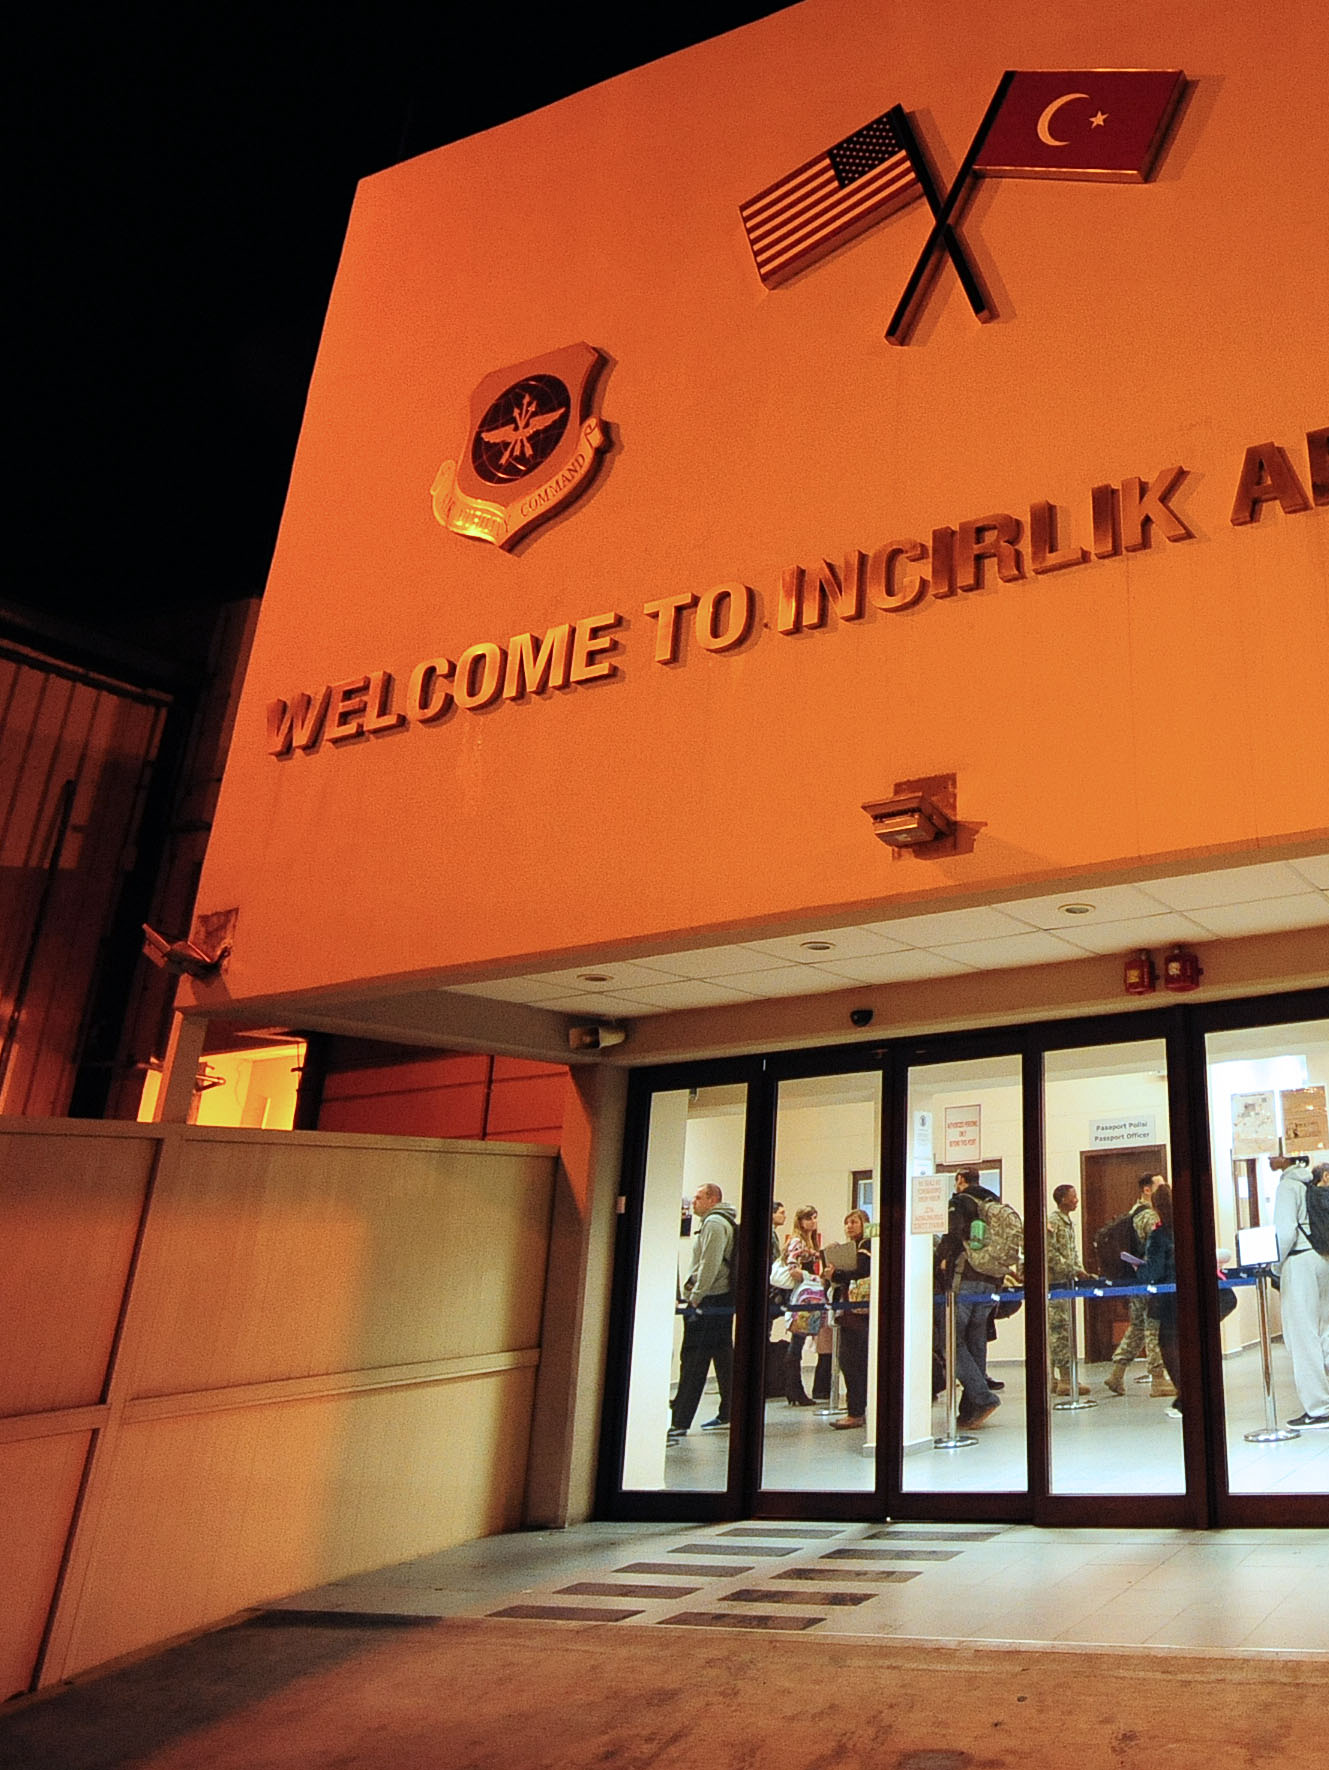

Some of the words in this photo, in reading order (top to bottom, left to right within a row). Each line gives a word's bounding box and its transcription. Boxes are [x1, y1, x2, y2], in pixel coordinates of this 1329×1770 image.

[519, 453, 586, 518] COMMAND
[266, 611, 624, 760] WELCOME
[643, 581, 753, 665] TO
[778, 465, 1198, 636] INCIRLIK
[1126, 1132, 1150, 1140] Officer
